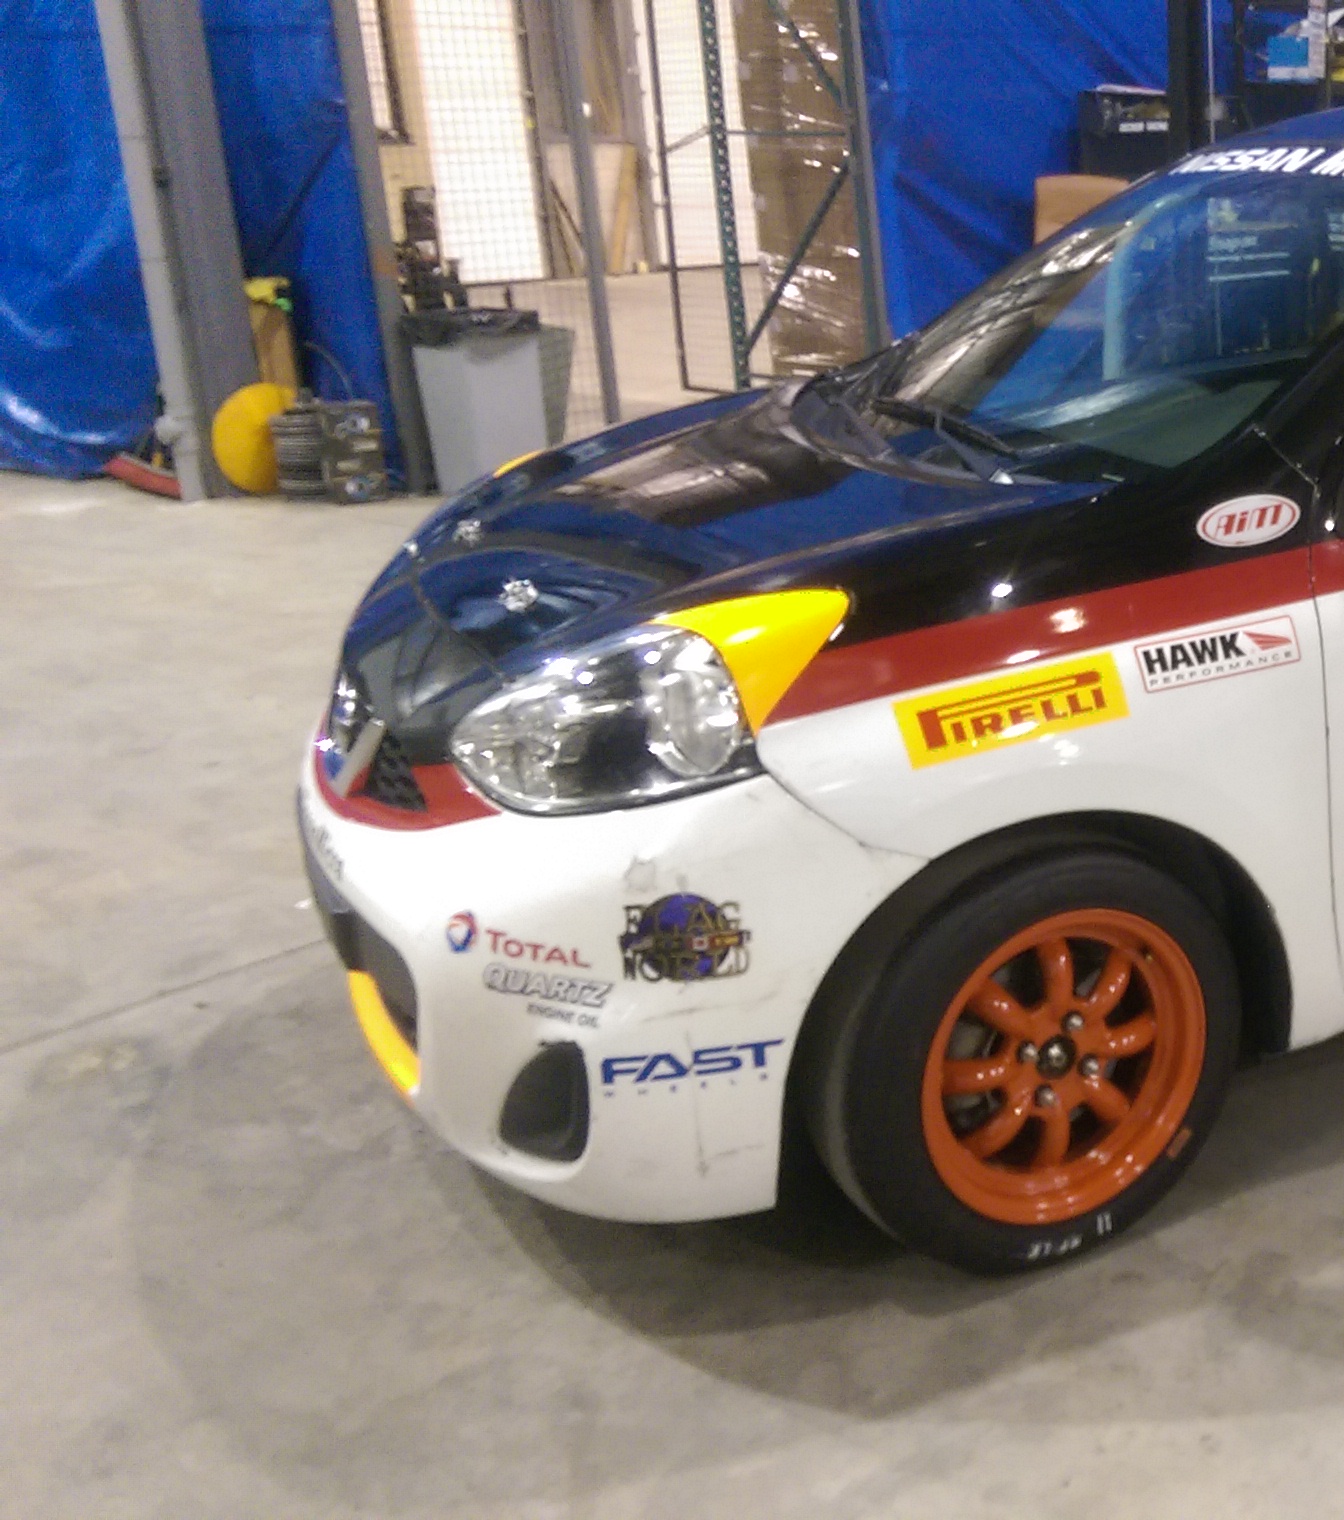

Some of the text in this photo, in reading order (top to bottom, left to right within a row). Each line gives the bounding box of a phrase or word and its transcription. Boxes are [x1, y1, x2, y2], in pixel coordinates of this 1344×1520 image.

[1168, 147, 1326, 176] NISSAN
[1143, 631, 1247, 676] HAWK
[1149, 650, 1293, 687] PERFORMANCE
[916, 670, 1107, 751] PIRELLI
[482, 961, 615, 1009] QUARTZ
[601, 1039, 785, 1084] FAST
